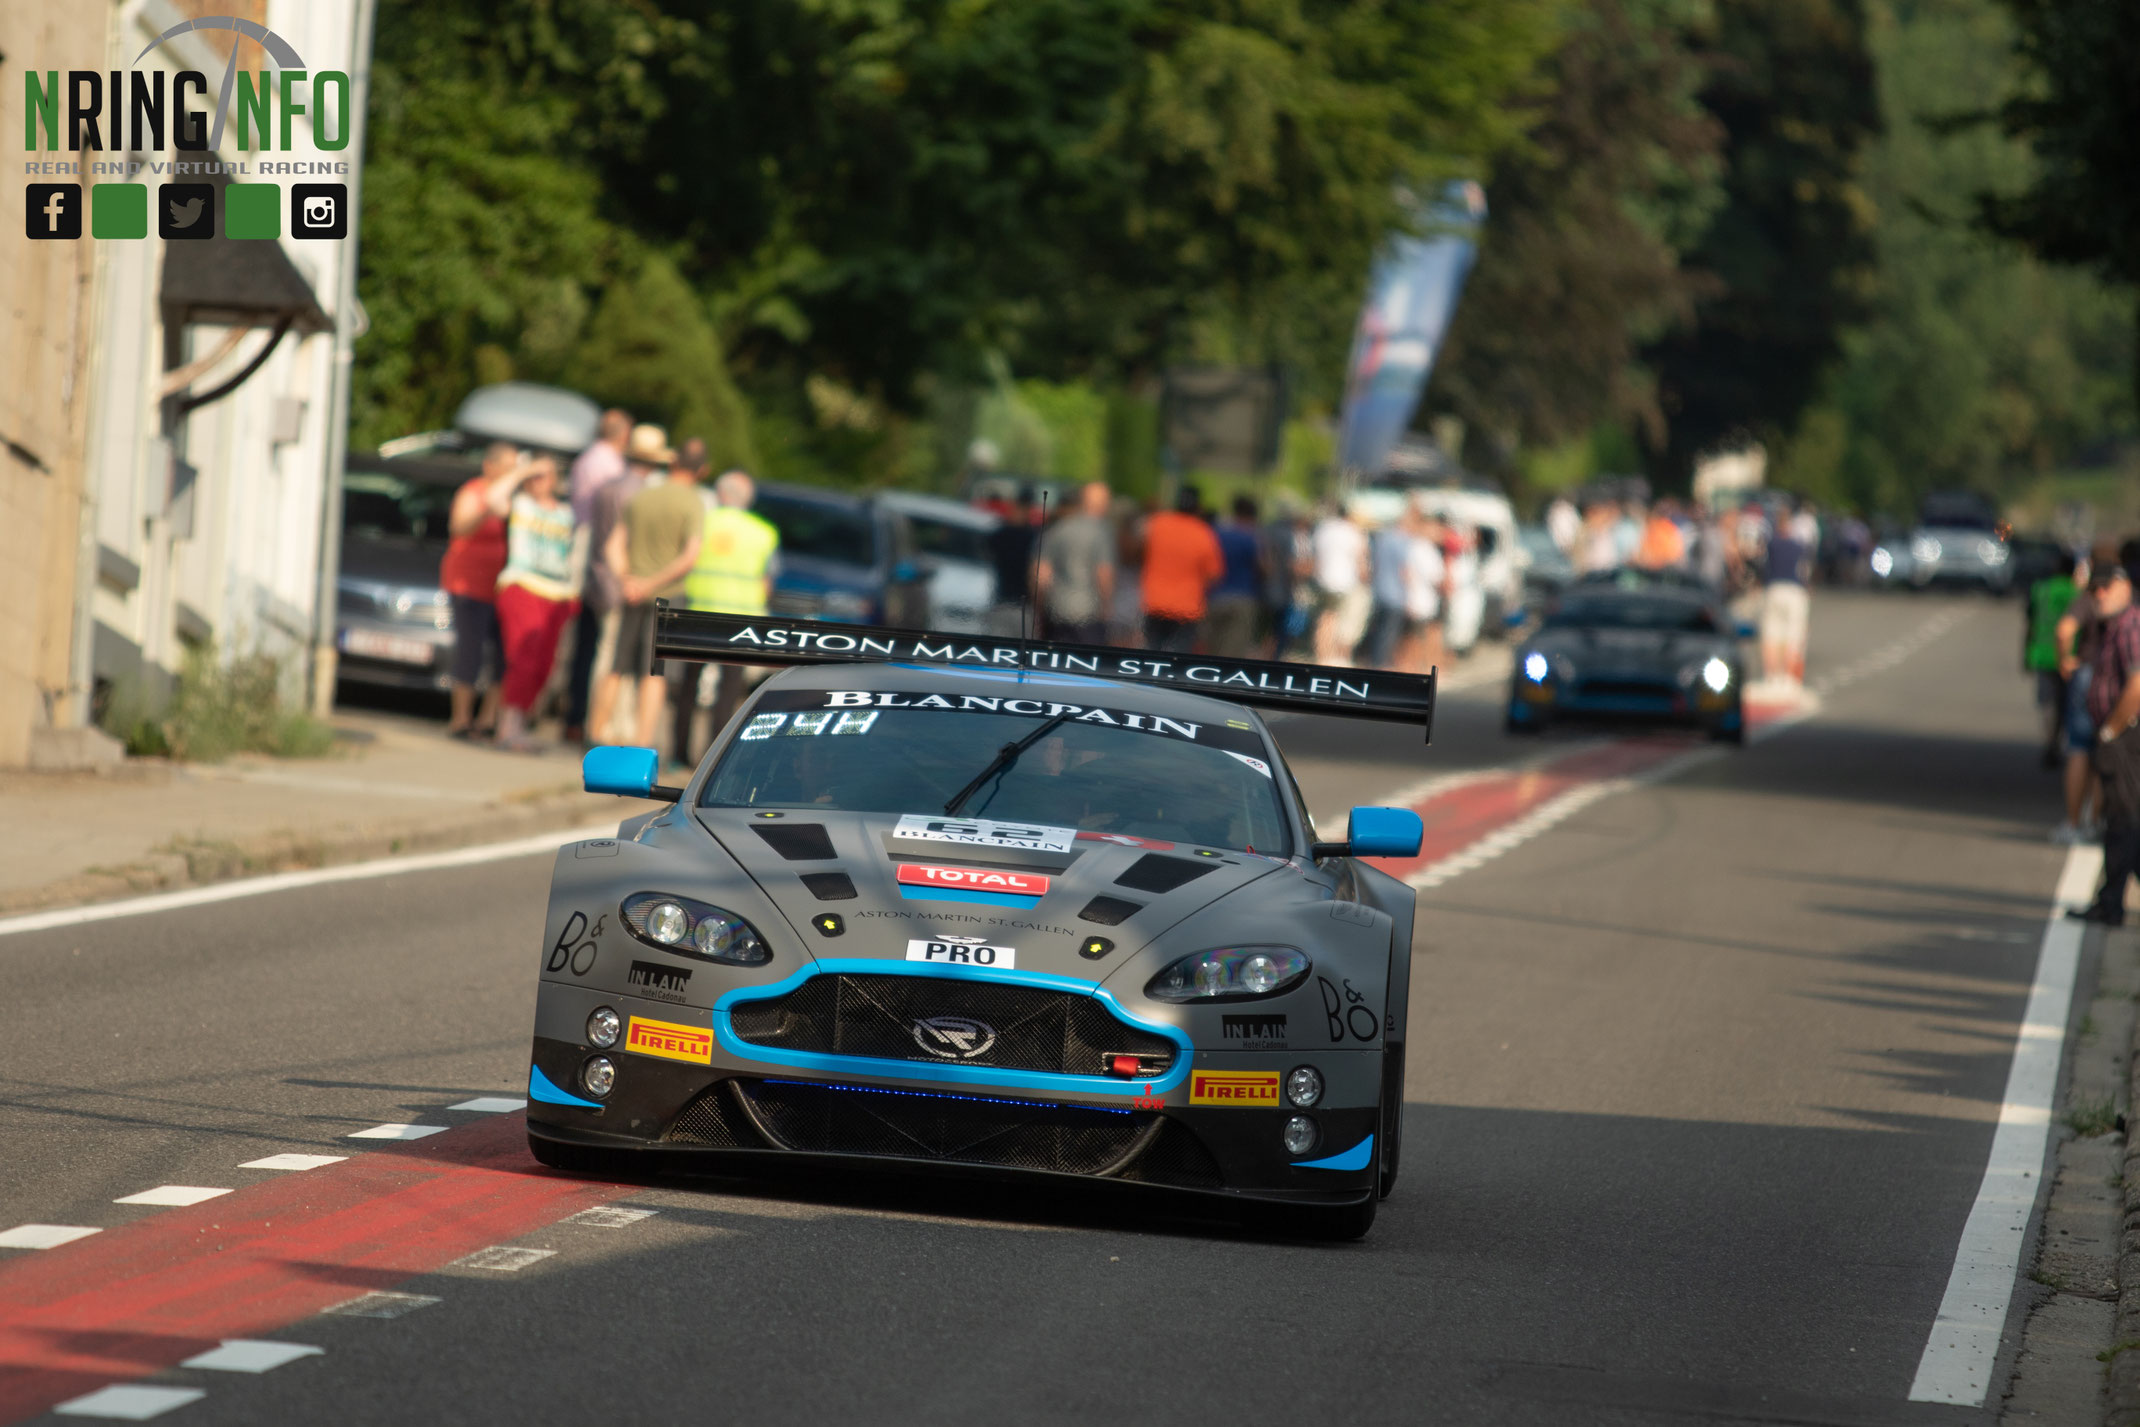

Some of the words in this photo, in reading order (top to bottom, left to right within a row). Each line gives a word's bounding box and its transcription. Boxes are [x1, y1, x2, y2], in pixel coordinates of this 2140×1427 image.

[729, 626, 895, 654] ASTON
[912, 642, 1098, 671] MARTIN
[740, 711, 879, 740] 24H
[823, 691, 1203, 739] BLANCPAIN
[900, 831, 1064, 851] BLANCPAIN
[920, 867, 1028, 887] TOTAL
[855, 910, 912, 919] ASTON
[916, 912, 982, 923] MARTIN
[925, 942, 996, 965] PRO
[641, 987, 658, 999] Hotel
[630, 1023, 711, 1056] PIRELLI
[1194, 1076, 1278, 1099] PIRELLI
[1133, 1097, 1165, 1110] TOW
